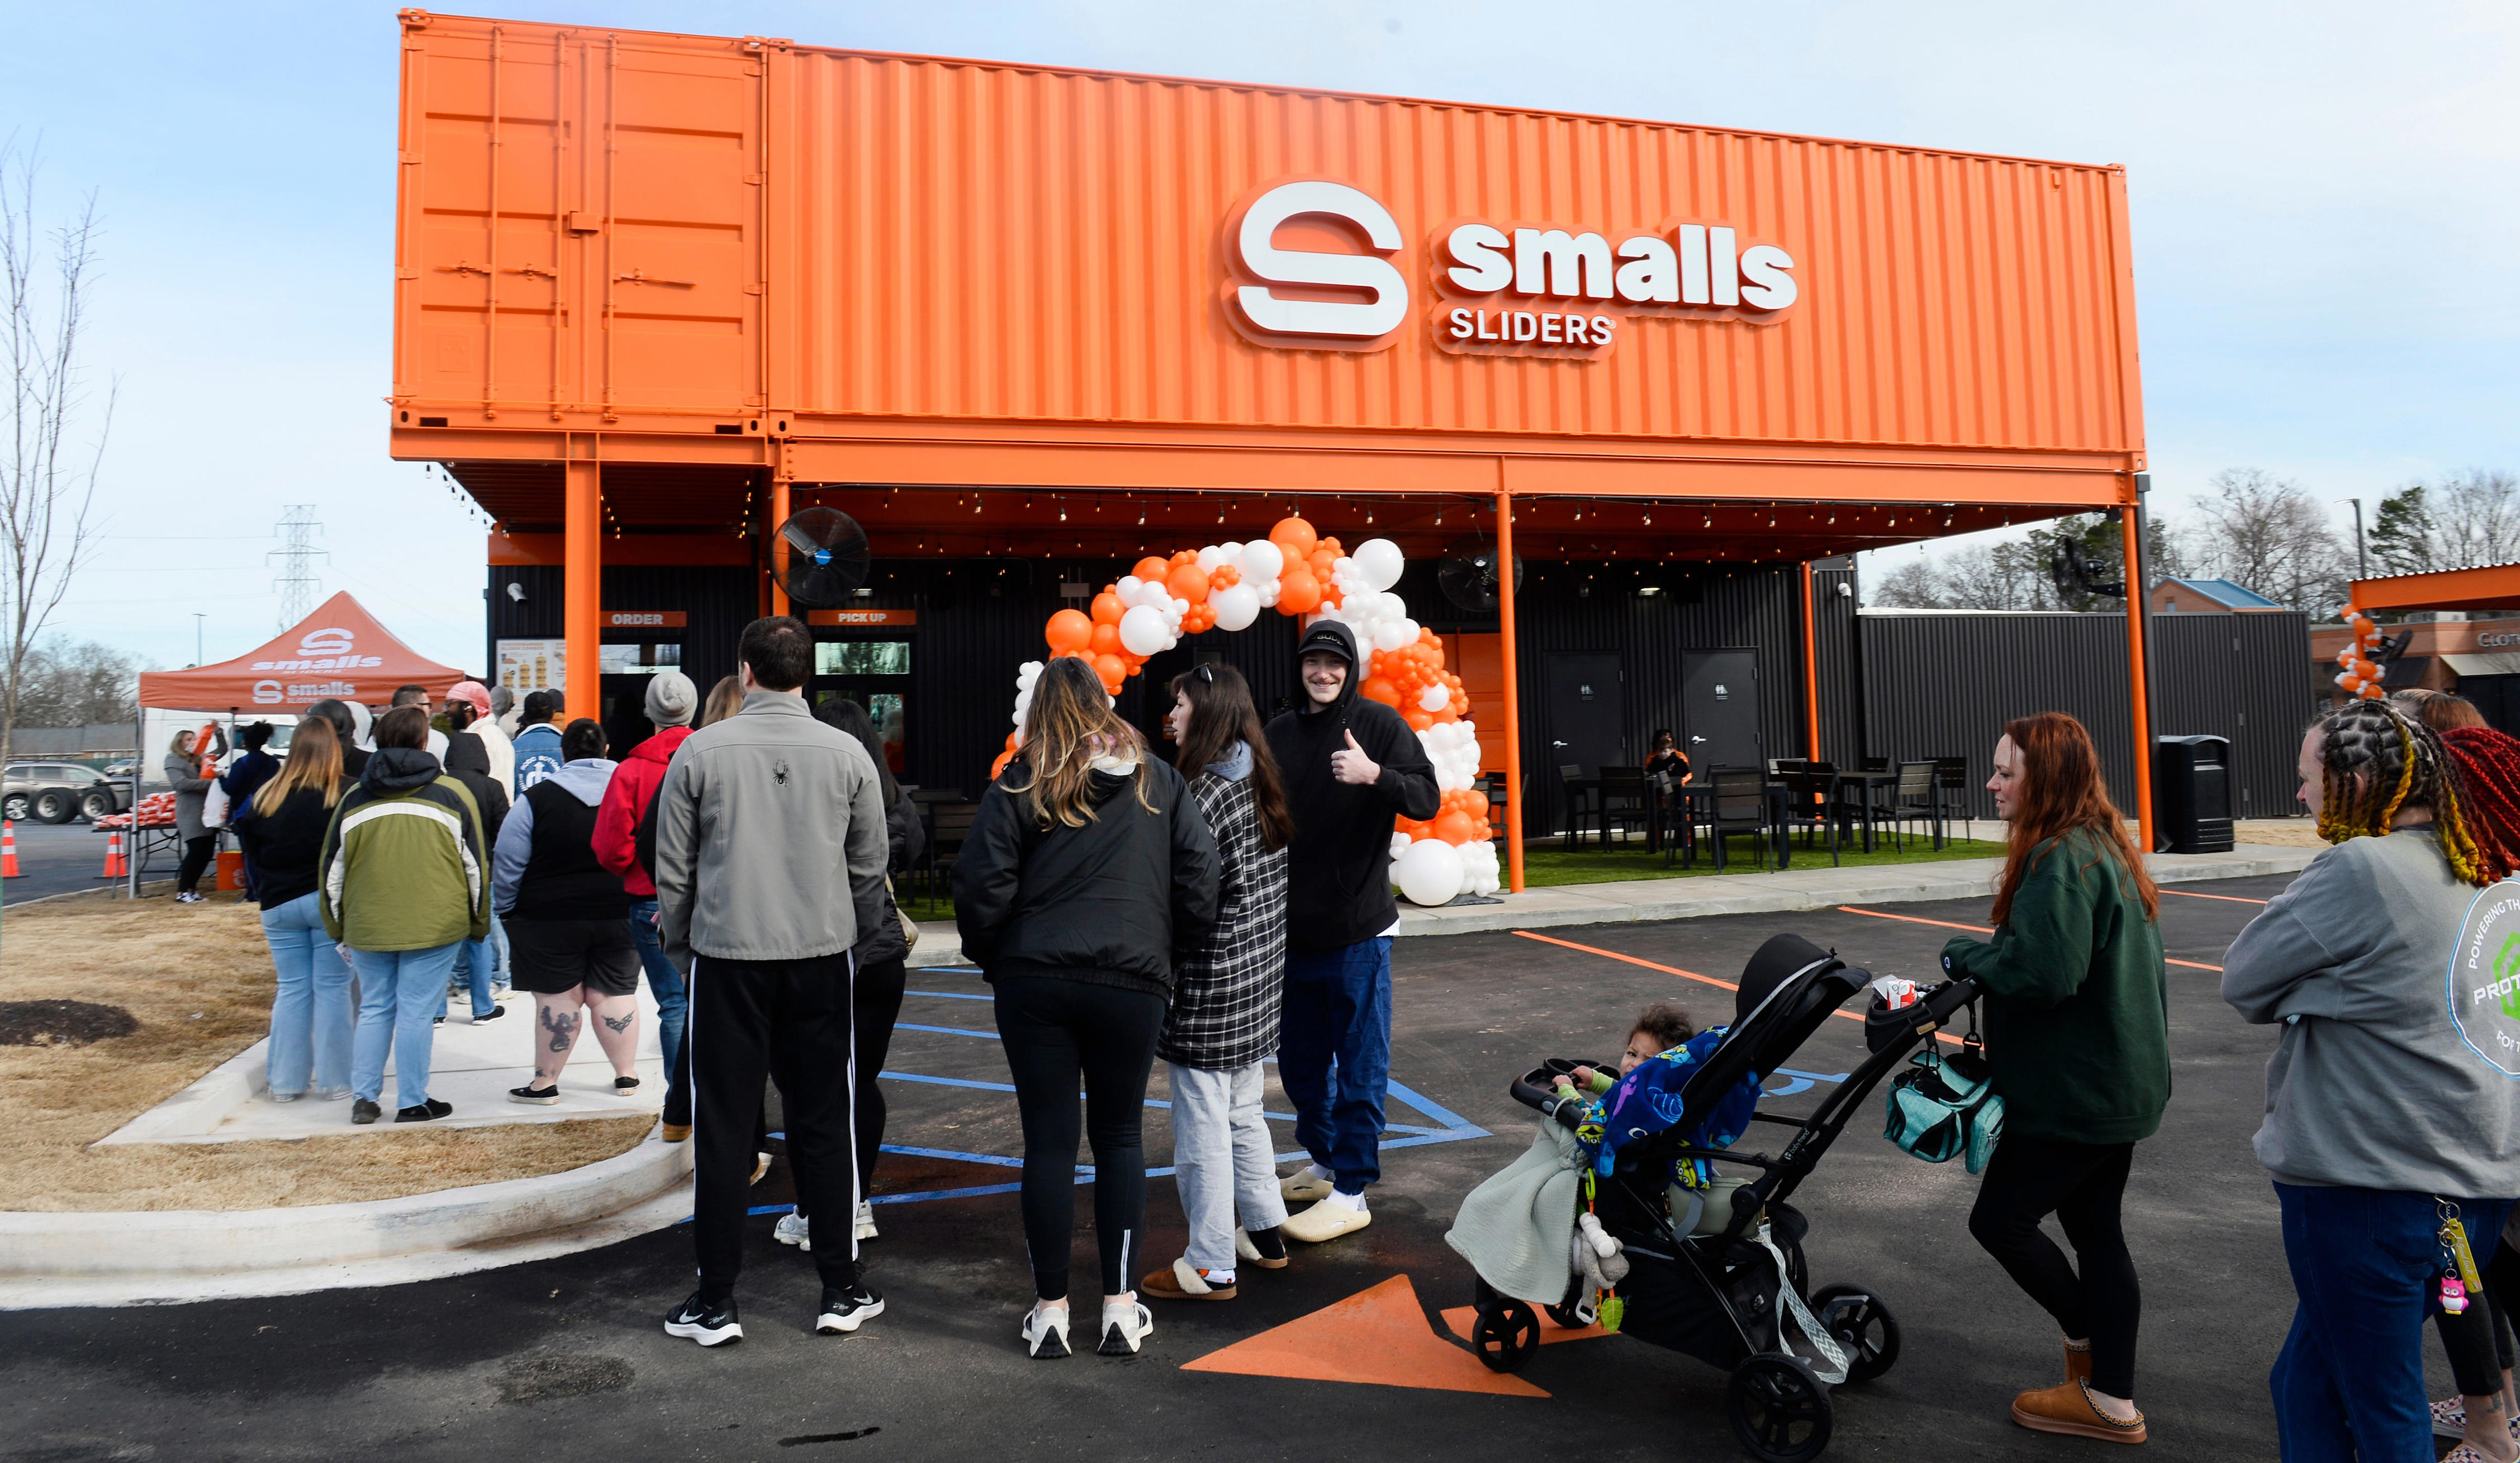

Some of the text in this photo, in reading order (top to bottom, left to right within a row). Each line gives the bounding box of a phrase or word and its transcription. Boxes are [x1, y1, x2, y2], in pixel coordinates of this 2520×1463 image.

[1448, 223, 1798, 310] smalls
[611, 614, 663, 624] ORDER
[838, 613, 887, 622] PICK UP
[2477, 633, 2520, 647] CLOT
[250, 655, 383, 670] smalls
[287, 681, 356, 696] smalls
[2468, 901, 2506, 969] POWERING
